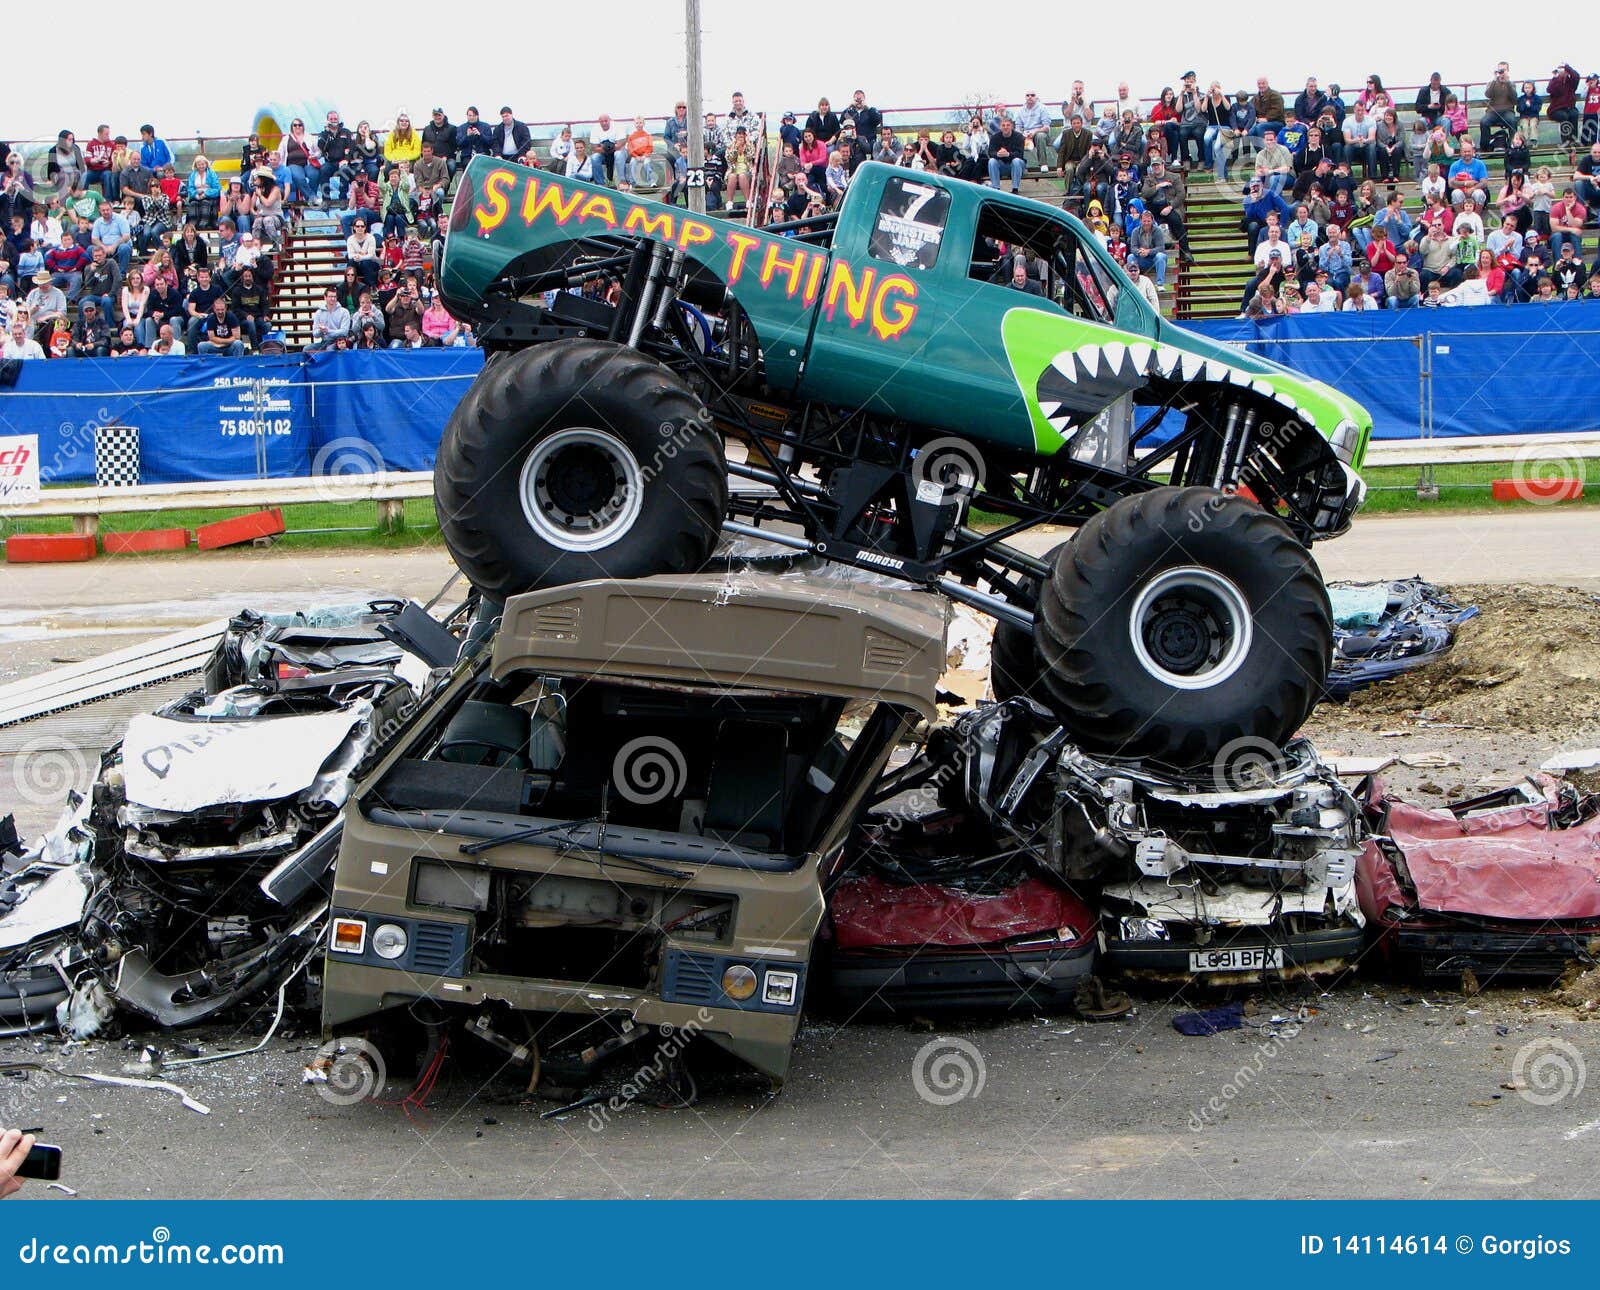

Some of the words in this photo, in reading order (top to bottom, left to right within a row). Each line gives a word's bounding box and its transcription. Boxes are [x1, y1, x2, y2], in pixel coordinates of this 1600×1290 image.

[686, 169, 704, 187] 23
[901, 181, 937, 221] 7
[474, 168, 715, 251] SWAMP
[727, 230, 918, 342] THING
[855, 550, 904, 570] MOROSO
